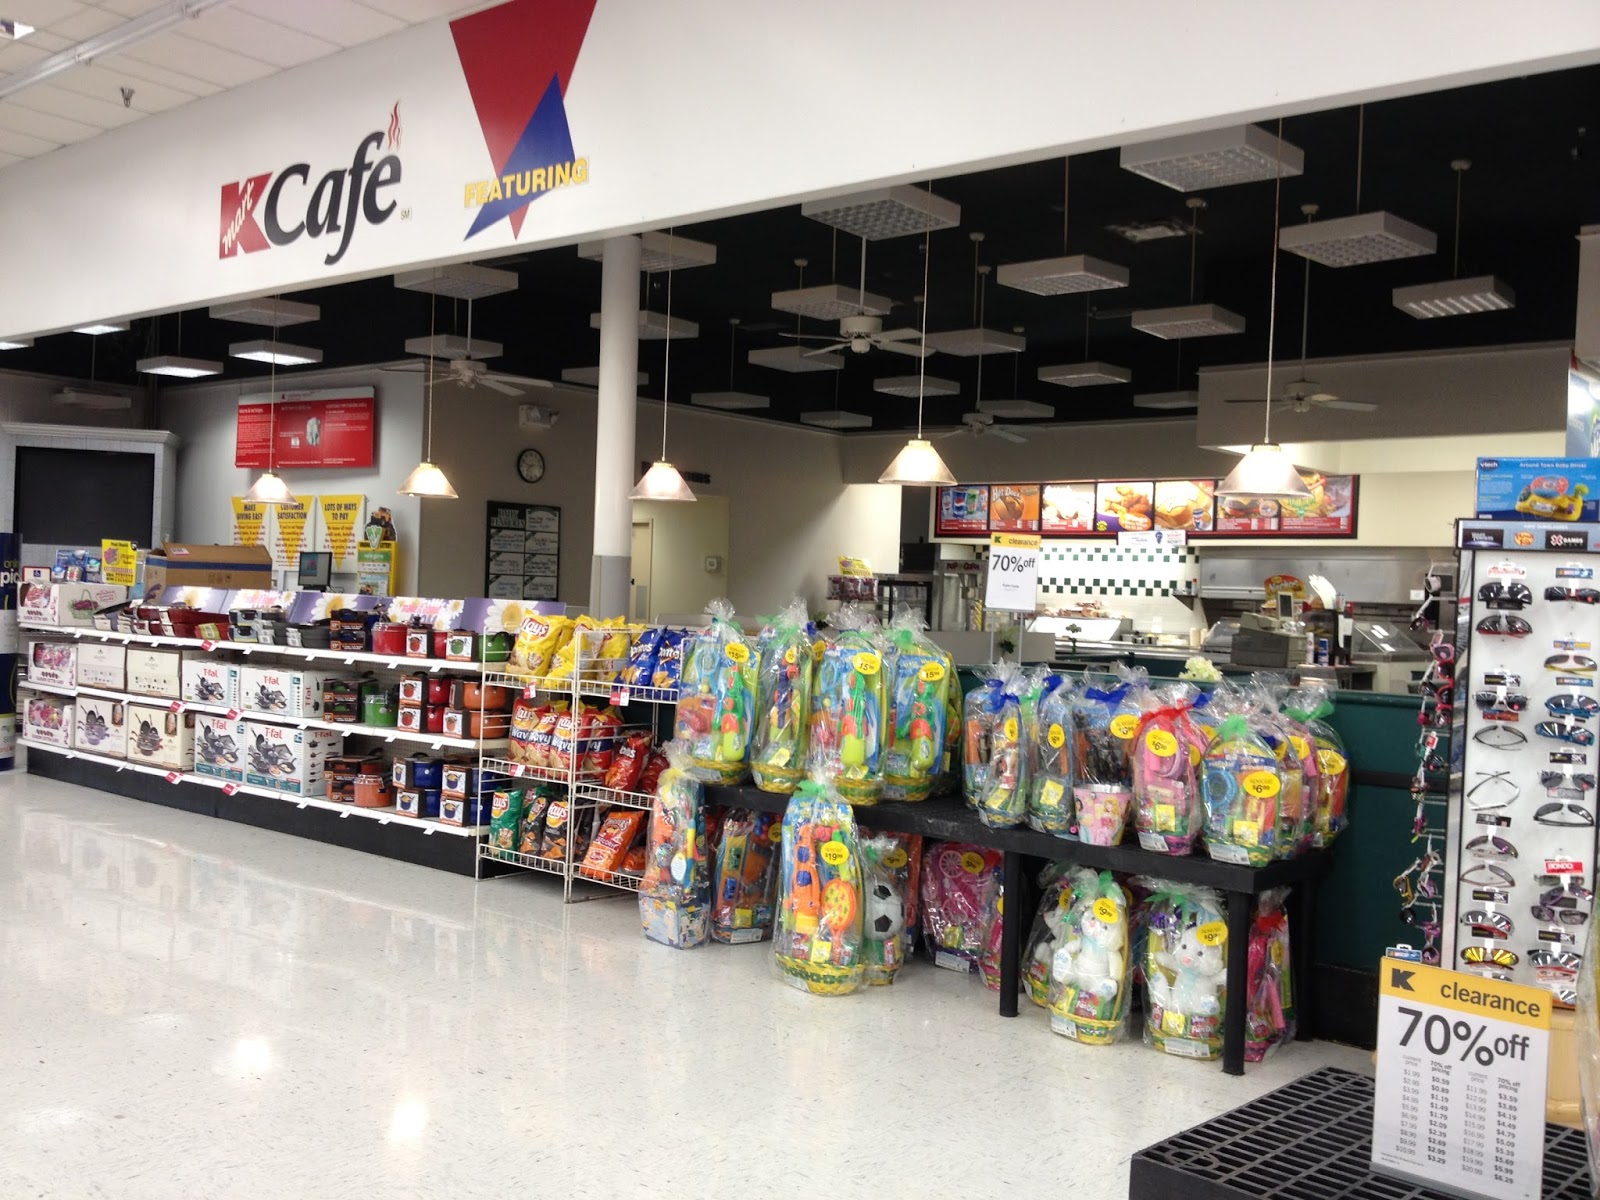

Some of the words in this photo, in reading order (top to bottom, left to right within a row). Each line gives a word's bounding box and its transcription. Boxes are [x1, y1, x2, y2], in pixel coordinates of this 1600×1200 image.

[464, 157, 589, 208] FEATURING
[219, 171, 273, 260] K
[221, 180, 255, 255] mart
[344, 503, 357, 511] WAYS
[1008, 537, 1038, 547] clearance
[992, 554, 1024, 572] 70%
[1023, 558, 1035, 568] off
[203, 668, 218, 678] T-fal
[263, 676, 280, 686] T-fal
[211, 718, 227, 730] T-fal
[265, 727, 283, 740] T-fal
[1391, 968, 1416, 992] K
[1440, 982, 1541, 1018] clearance
[1398, 1006, 1494, 1067] 70%
[1494, 1033, 1530, 1061] off
[1430, 1060, 1443, 1068] 70%
[1432, 1076, 1450, 1085] $0.59
[1432, 1085, 1449, 1094] $0.89
[1431, 1094, 1448, 1102] $1.19
[1499, 1094, 1517, 1102] $3.59
[1430, 1103, 1448, 1111] $1.49
[1498, 1102, 1517, 1111] $3.89
[1430, 1111, 1448, 1120] $1.79
[1498, 1111, 1516, 1120] $4.19
[1429, 1120, 1447, 1129] $2.09
[1497, 1120, 1516, 1129] $4.49
[1429, 1129, 1446, 1137] $2.39
[1497, 1129, 1515, 1138] $4.79
[1428, 1137, 1446, 1146] $2.69
[1496, 1138, 1515, 1148] $5.09
[1428, 1146, 1445, 1155] $2.99
[1496, 1147, 1514, 1156] $5.39
[1428, 1155, 1445, 1164] $3.29
[1495, 1156, 1514, 1166] $5.69
[1494, 1165, 1513, 1175] $5.99
[1494, 1174, 1513, 1184] $6.29
